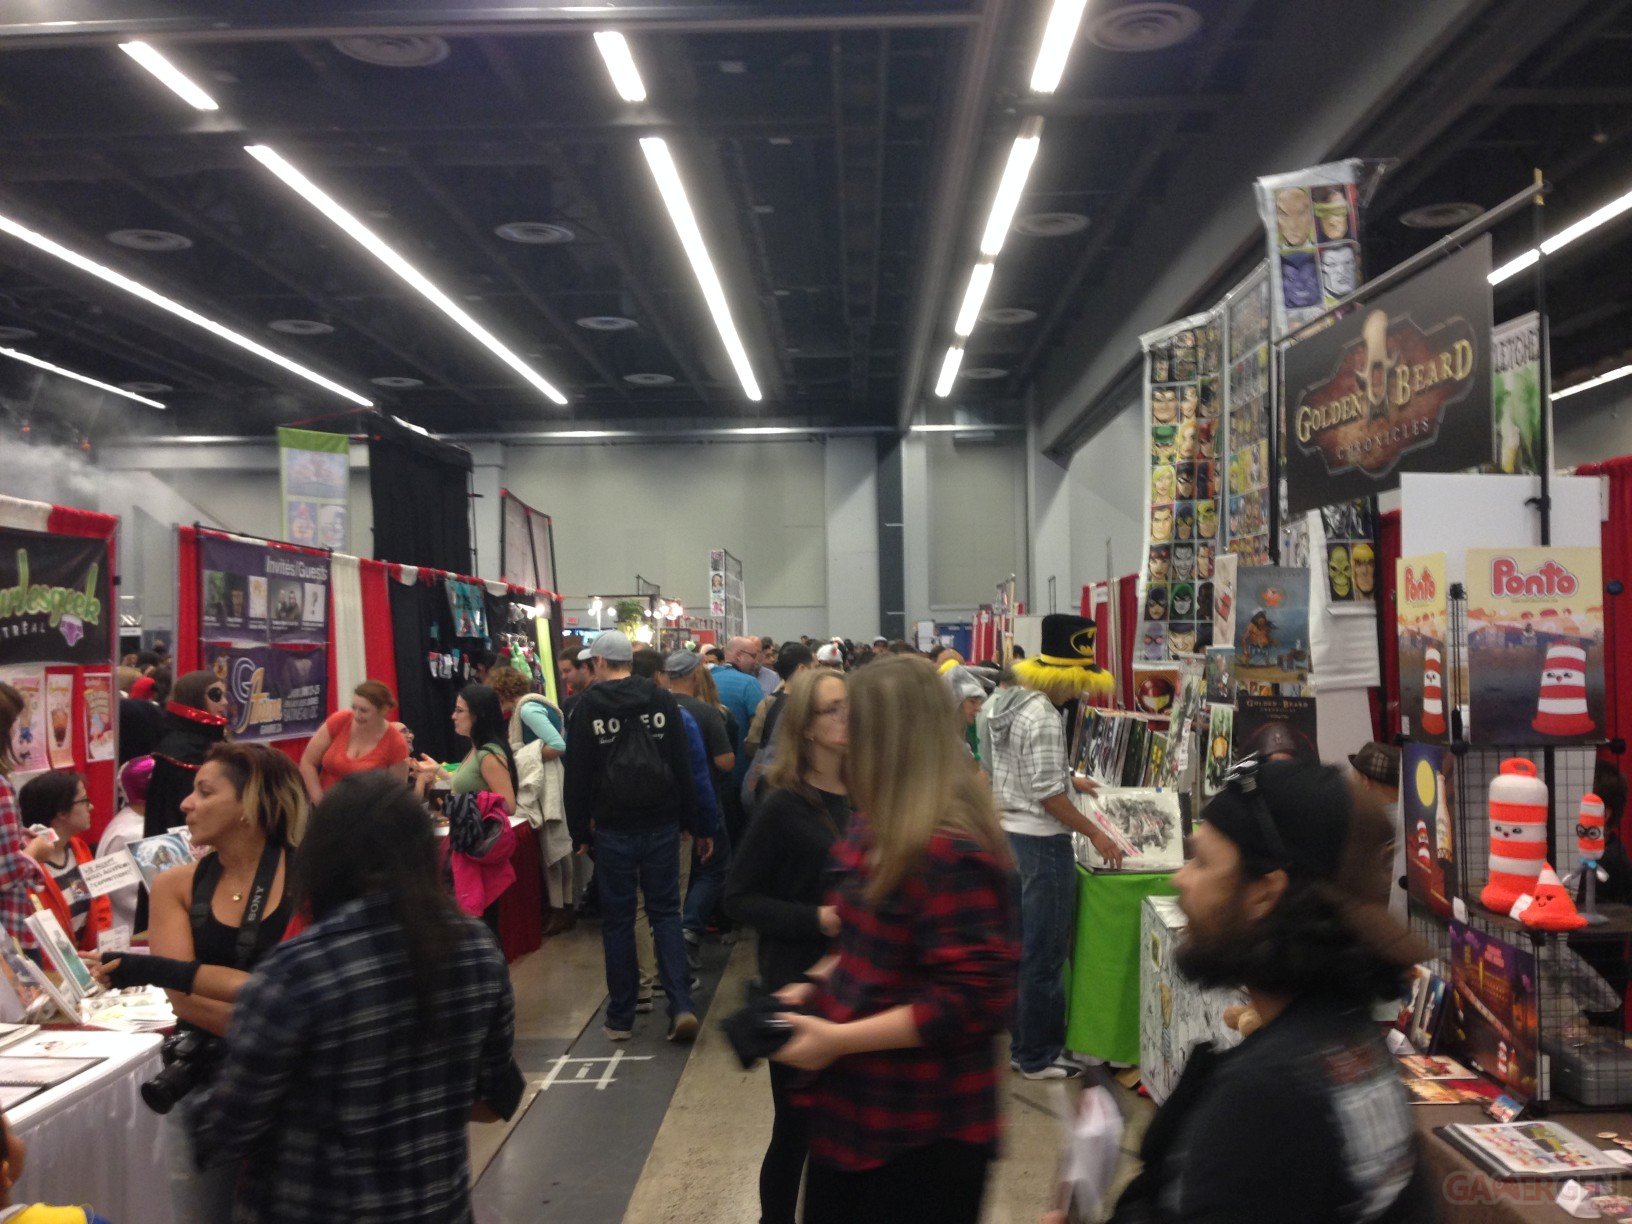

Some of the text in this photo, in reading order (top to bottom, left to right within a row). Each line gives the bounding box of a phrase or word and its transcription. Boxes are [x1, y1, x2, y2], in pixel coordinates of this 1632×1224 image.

[1296, 338, 1474, 443] GOLDEN BEARD
[1336, 416, 1430, 460] CHRONICLES
[1404, 565, 1436, 602] Ponto
[1491, 556, 1579, 598] Ponto
[592, 712, 666, 736] ROEO
[247, 884, 265, 922] SONY
